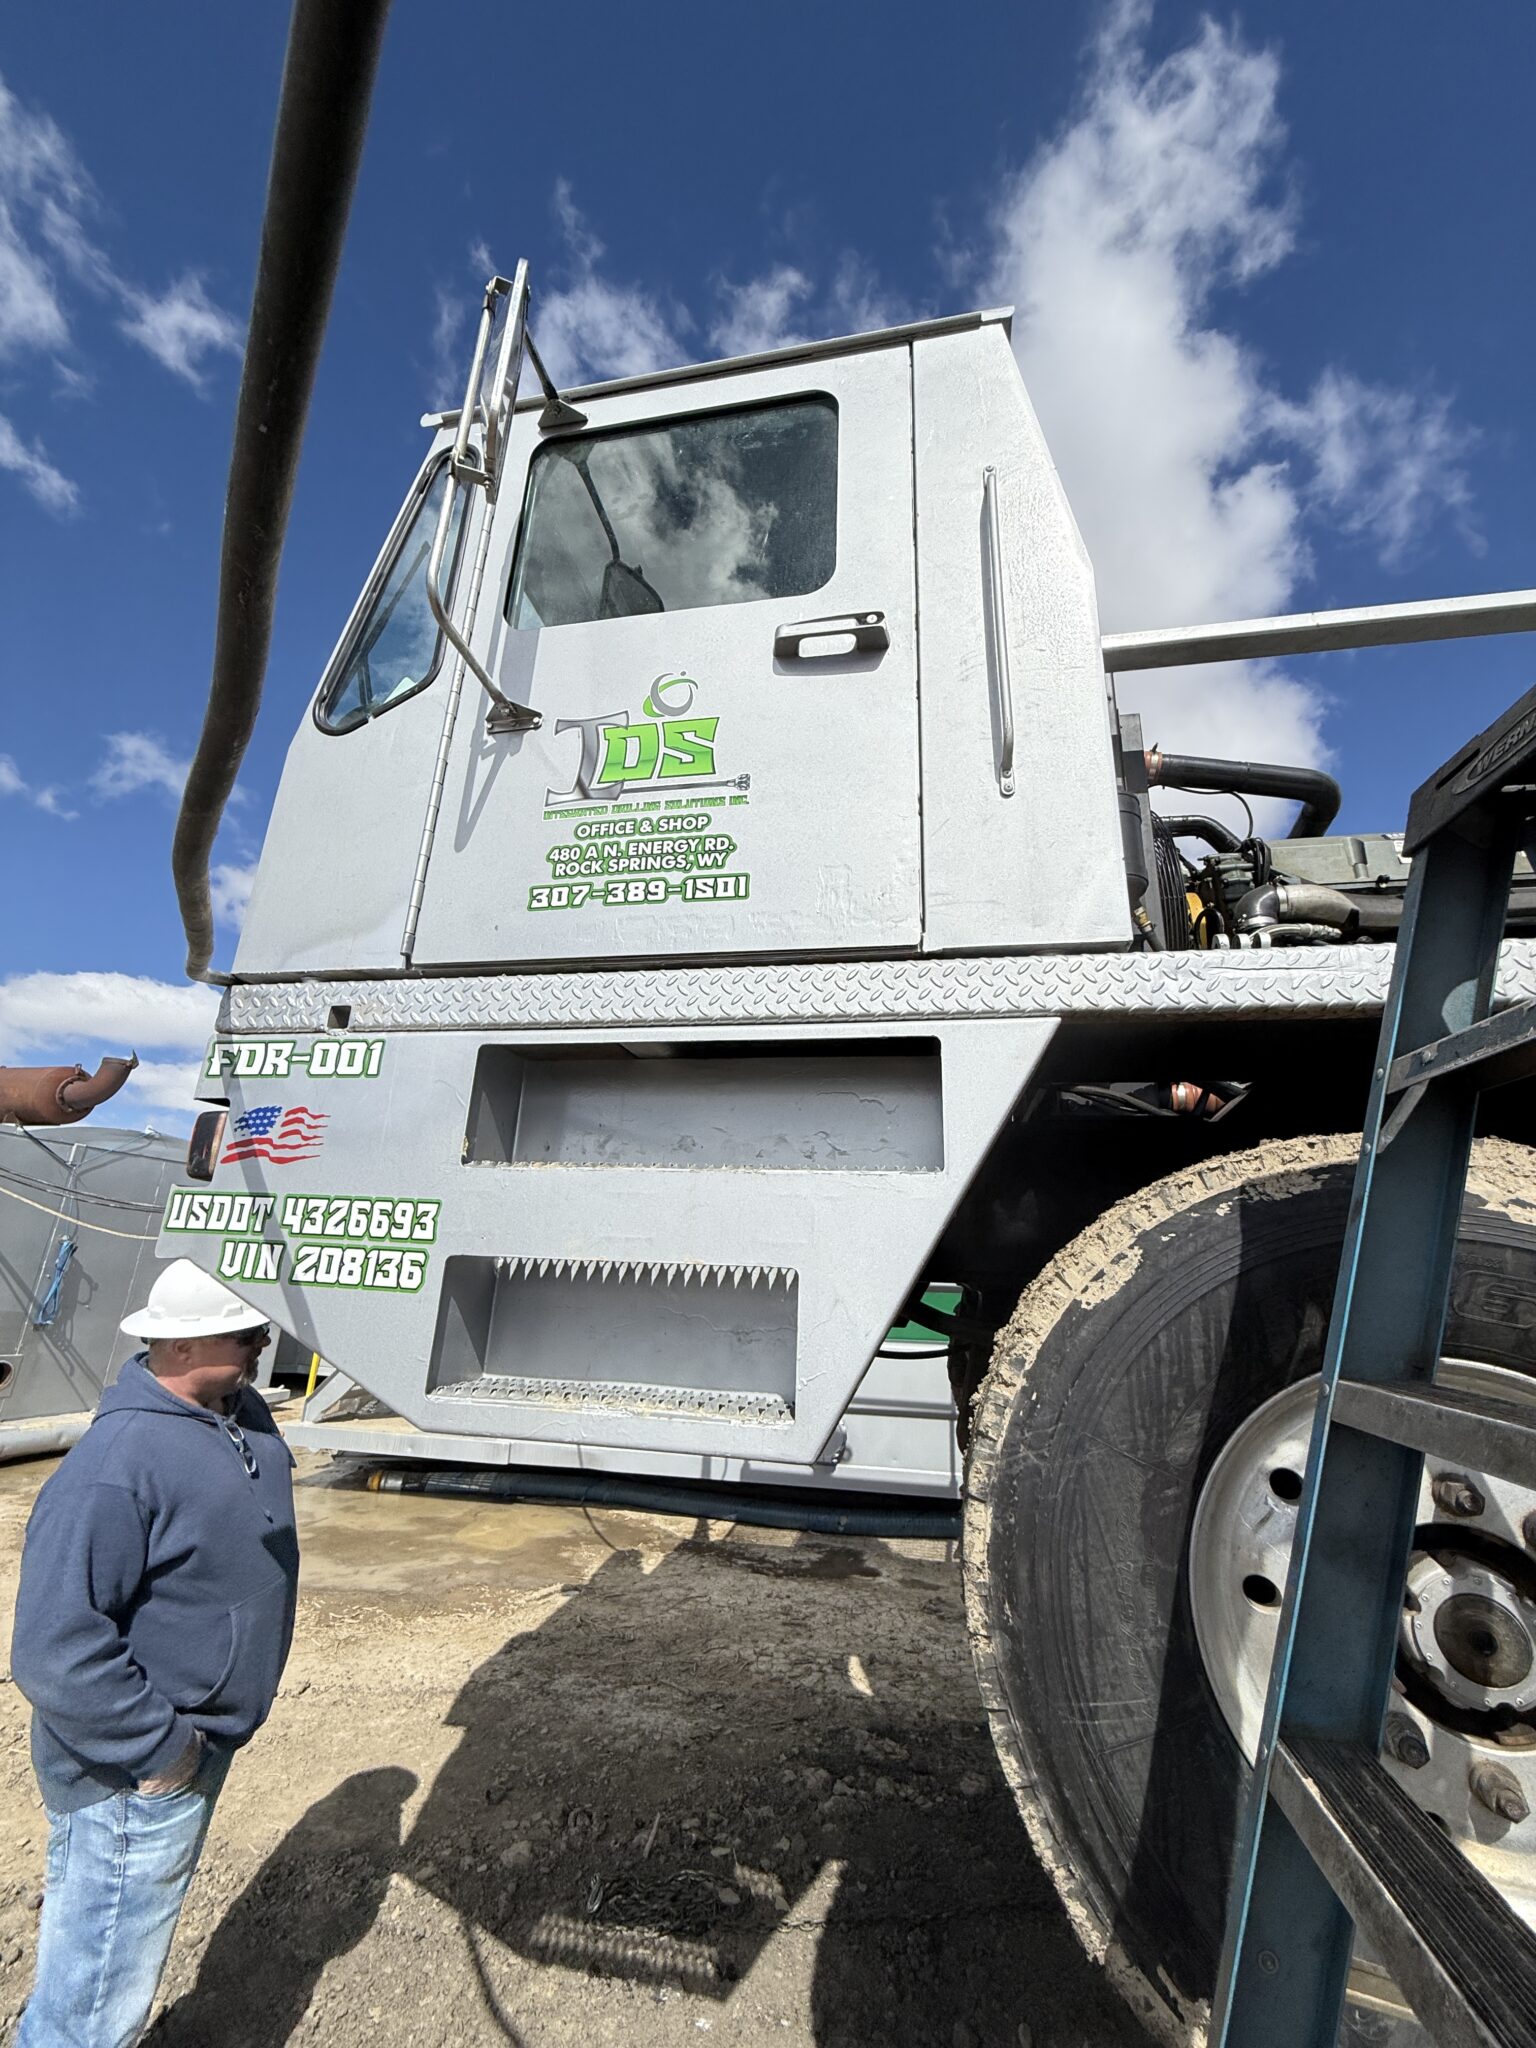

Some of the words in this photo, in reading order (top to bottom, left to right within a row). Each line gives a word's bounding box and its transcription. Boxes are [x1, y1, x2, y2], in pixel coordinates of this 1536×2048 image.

[1477, 711, 1536, 775] WERN
[576, 820, 635, 839] OFFICE
[639, 817, 653, 834] &
[658, 814, 709, 832] SHOP
[549, 845, 580, 862] 480
[585, 844, 599, 860] A
[603, 843, 623, 859] N.
[627, 838, 700, 857] ENERGY
[703, 836, 735, 852] RD.
[554, 861, 604, 878] ROCK
[607, 855, 693, 873] SPRINGS,
[697, 852, 729, 868] WY
[529, 874, 748, 909] 307-389-1501
[206, 1040, 385, 1077] FDR-001
[165, 1193, 276, 1233] USDOT
[281, 1196, 440, 1242] 4326693
[220, 1240, 286, 1281] VIN
[291, 1245, 427, 1290] 208136
